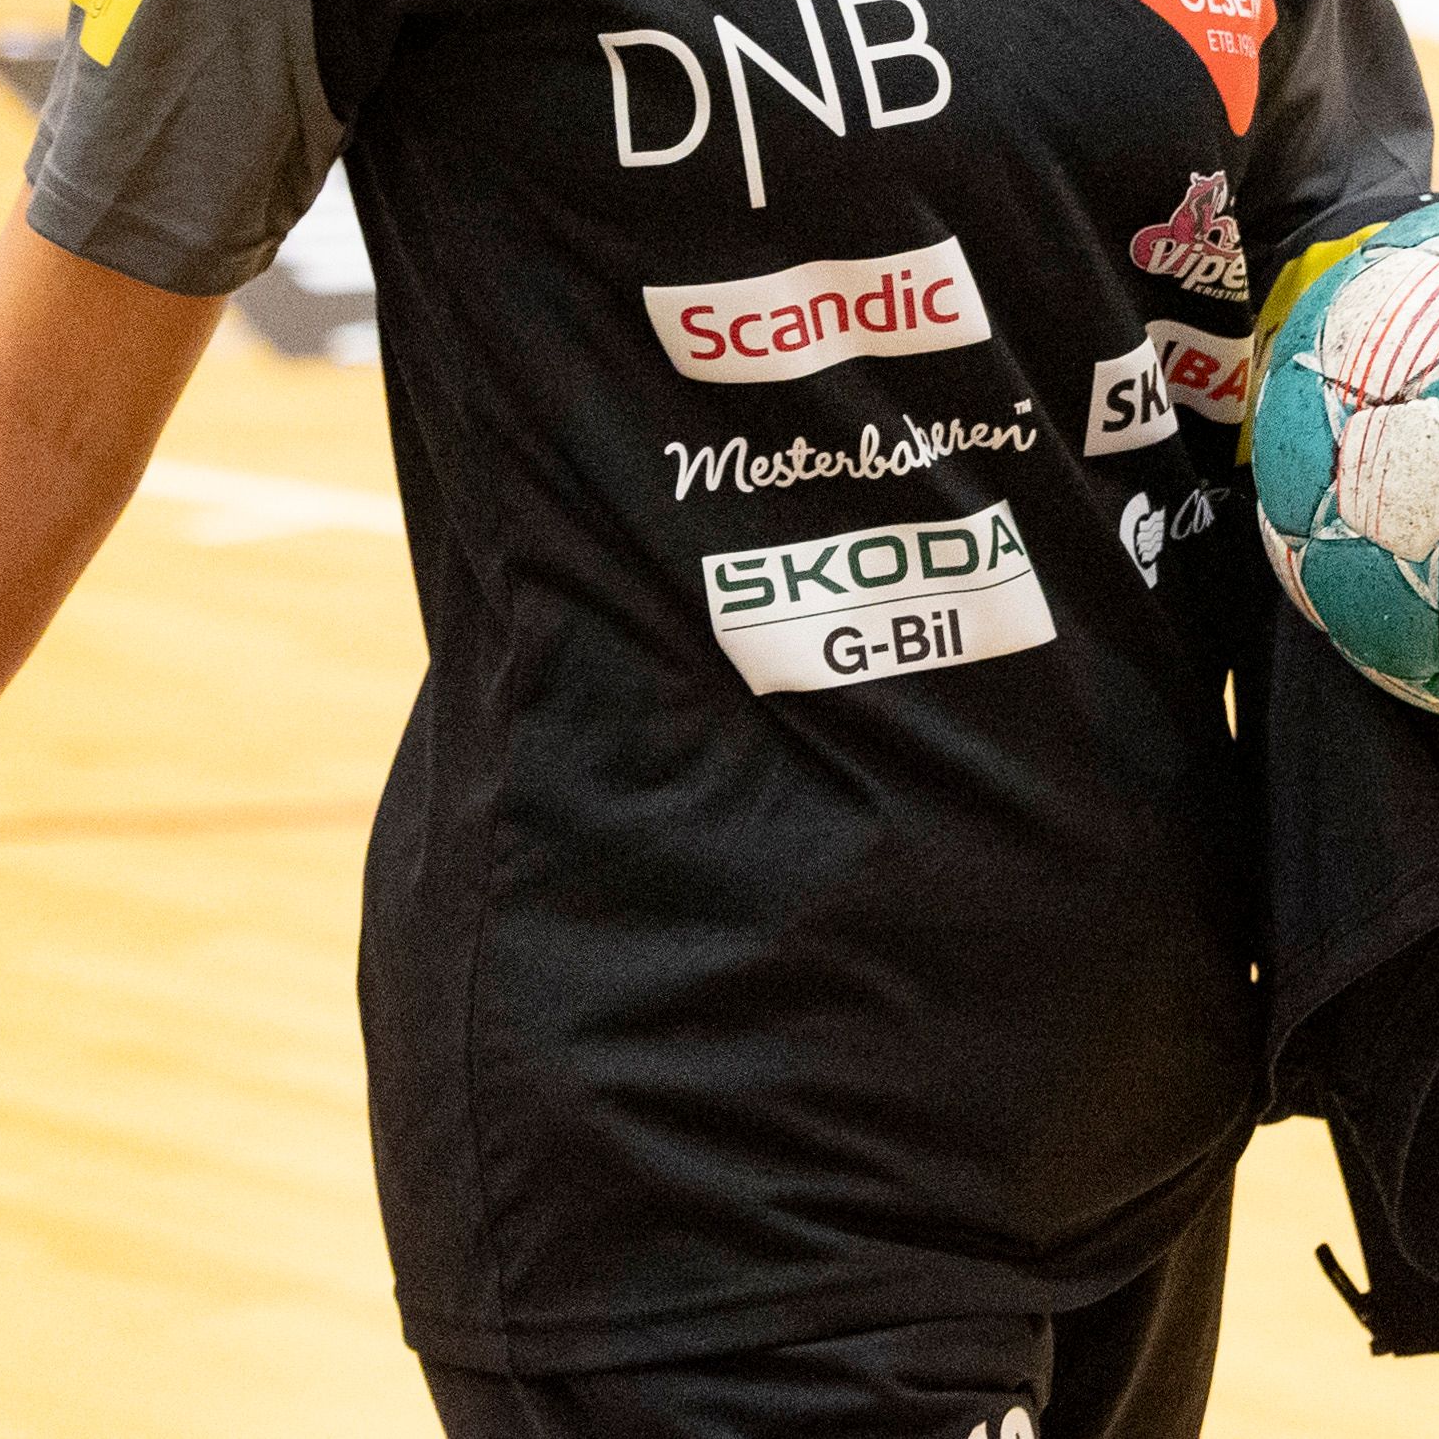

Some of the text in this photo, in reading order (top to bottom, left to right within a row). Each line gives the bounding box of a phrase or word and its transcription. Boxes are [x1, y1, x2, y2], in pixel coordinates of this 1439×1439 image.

[1145, 239, 1252, 291] Vipe
[679, 269, 961, 361] Scandic
[822, 608, 964, 676] G-Bil
